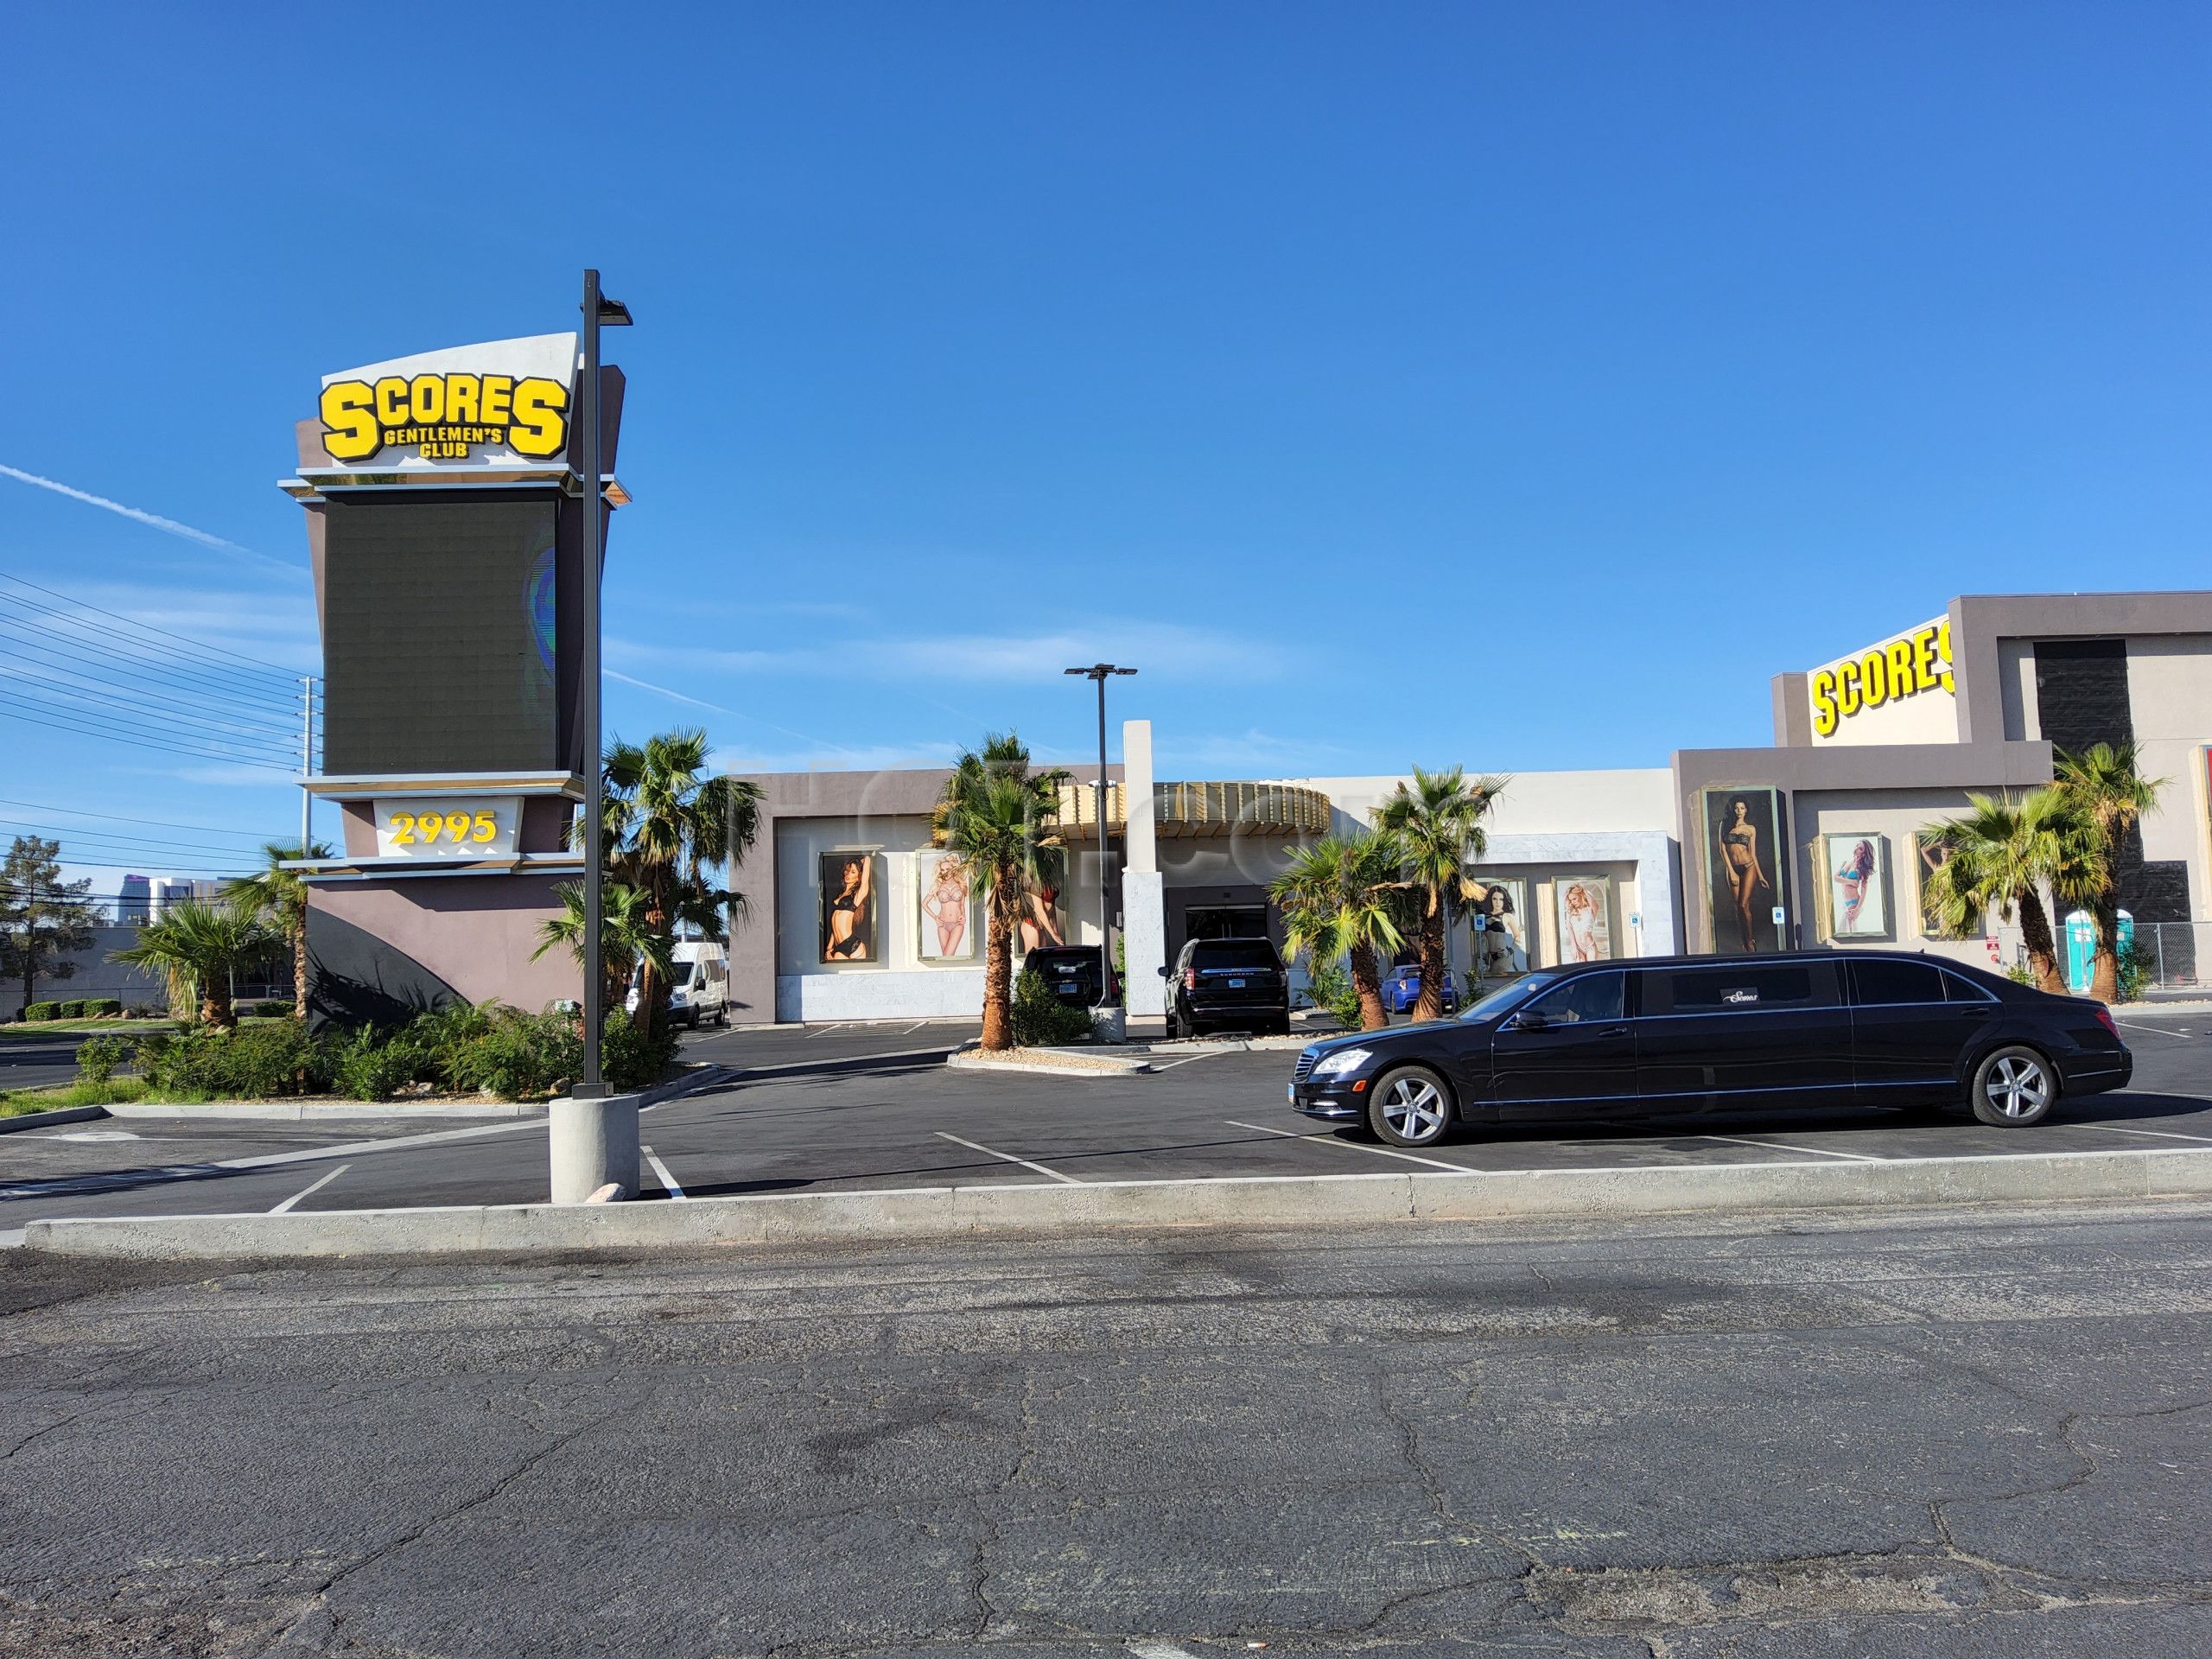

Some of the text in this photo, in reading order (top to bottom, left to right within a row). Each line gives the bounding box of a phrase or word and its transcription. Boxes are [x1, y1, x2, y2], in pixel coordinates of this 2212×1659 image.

[319, 372, 569, 461] SCORES
[384, 427, 503, 445] GENTLEMEN'S
[419, 443, 468, 458] CLUB
[390, 810, 497, 844] 2995
[1722, 990, 1758, 1003] Scores
